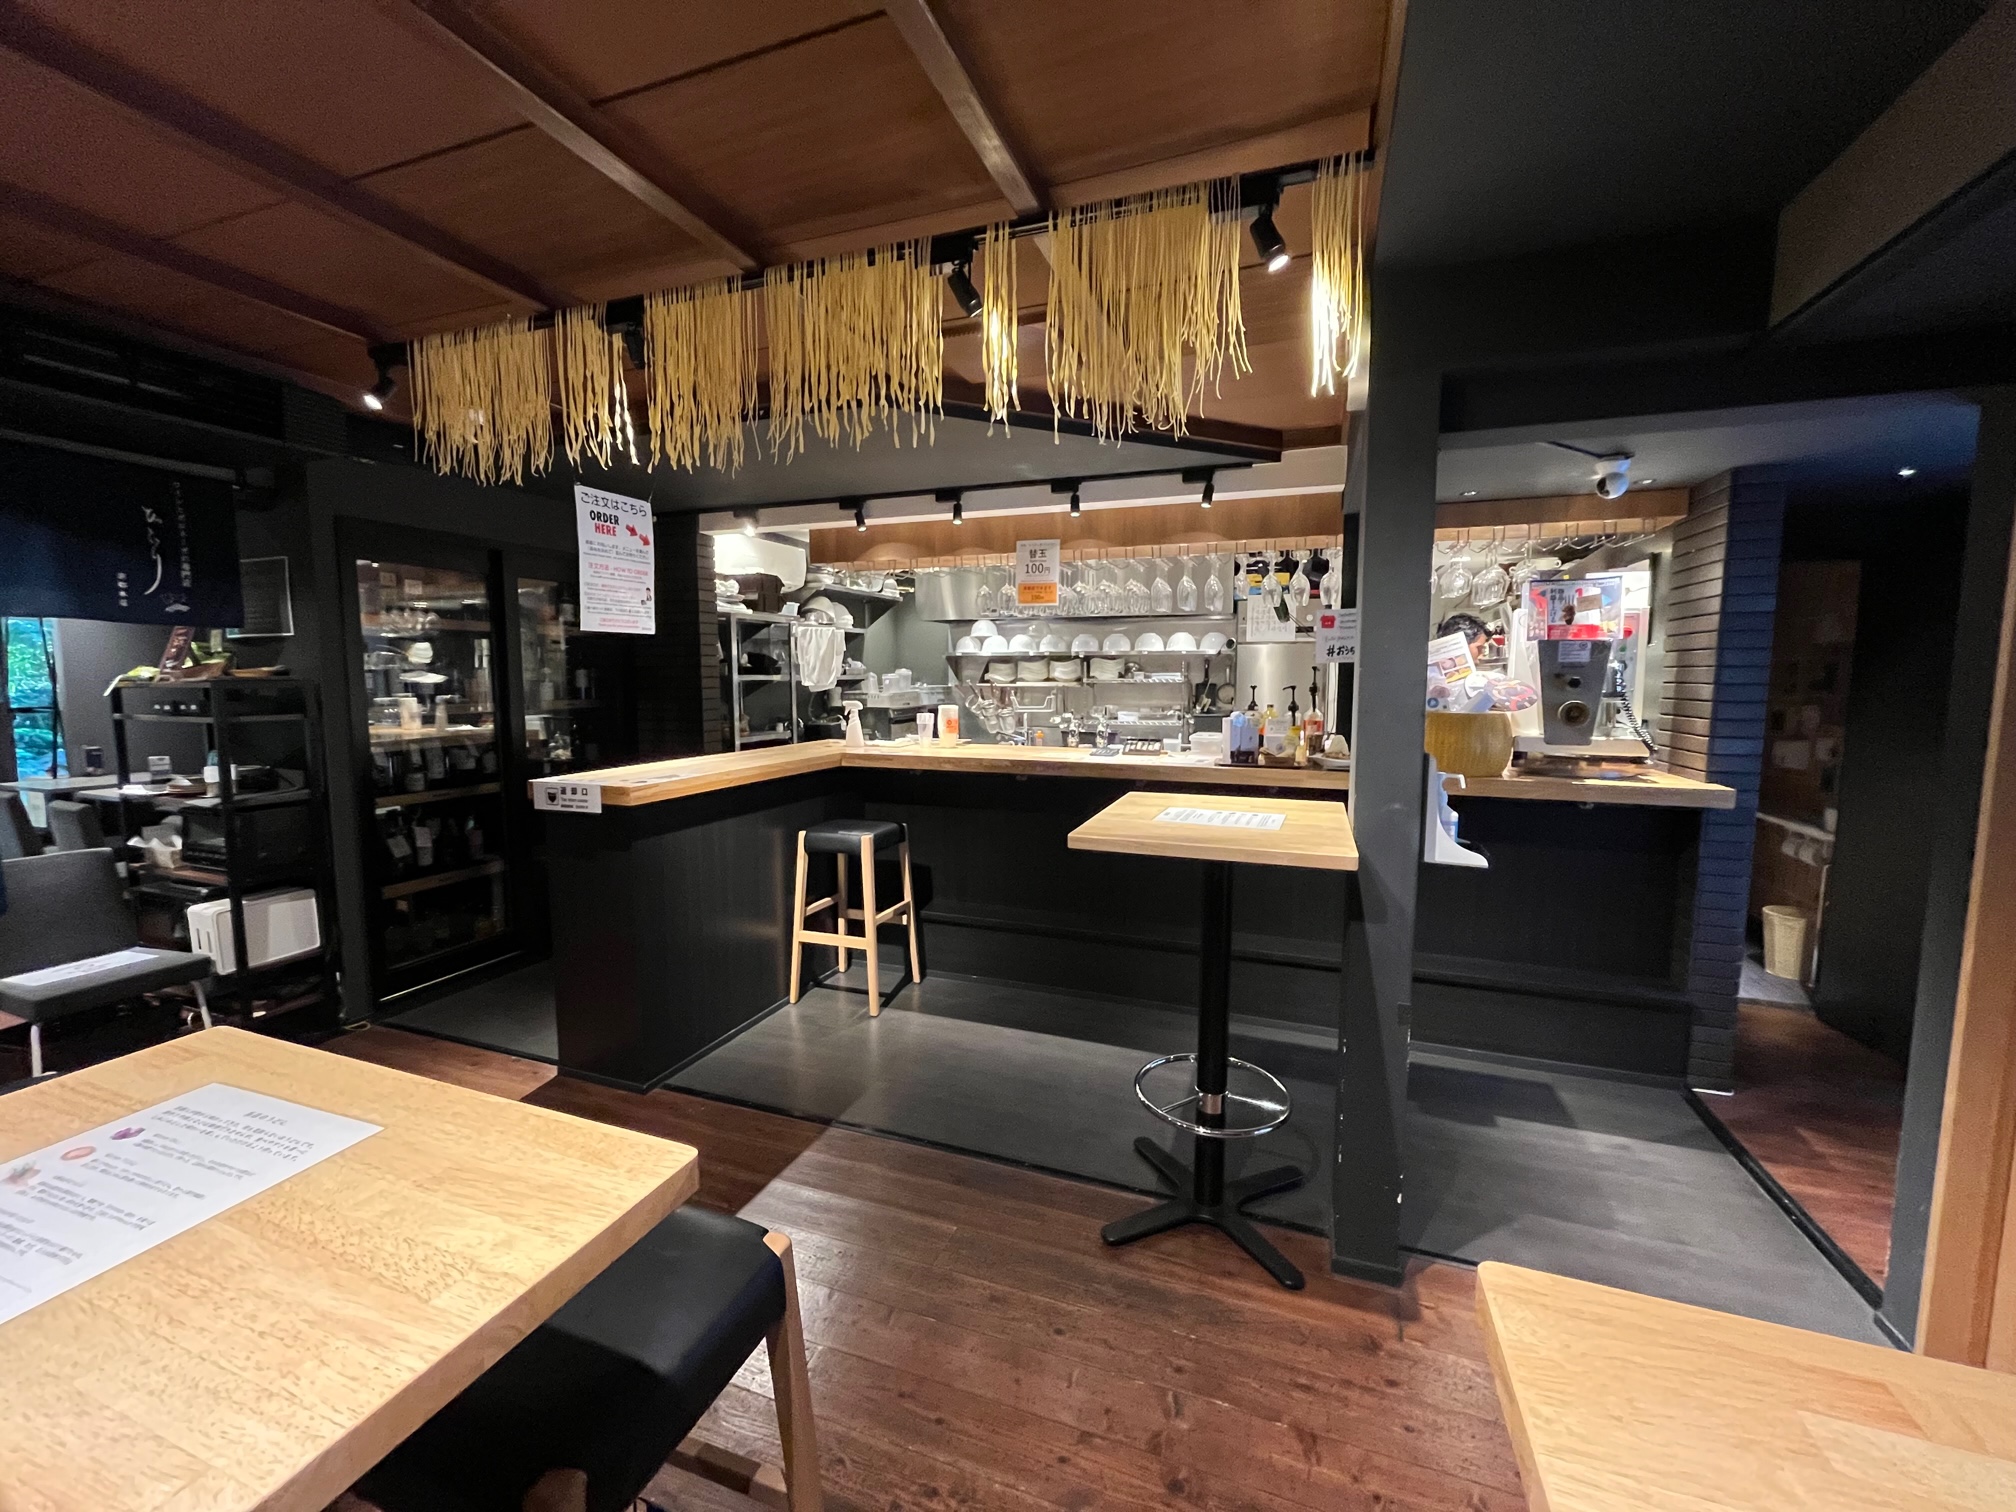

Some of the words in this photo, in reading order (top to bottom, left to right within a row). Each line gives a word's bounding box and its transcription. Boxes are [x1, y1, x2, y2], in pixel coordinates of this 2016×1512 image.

[581, 491, 647, 517] ご注文はこちら
[589, 510, 619, 526] ORDER
[595, 523, 617, 536] HERE
[1029, 549, 1047, 559] 替玉
[1025, 563, 1051, 574] 100円
